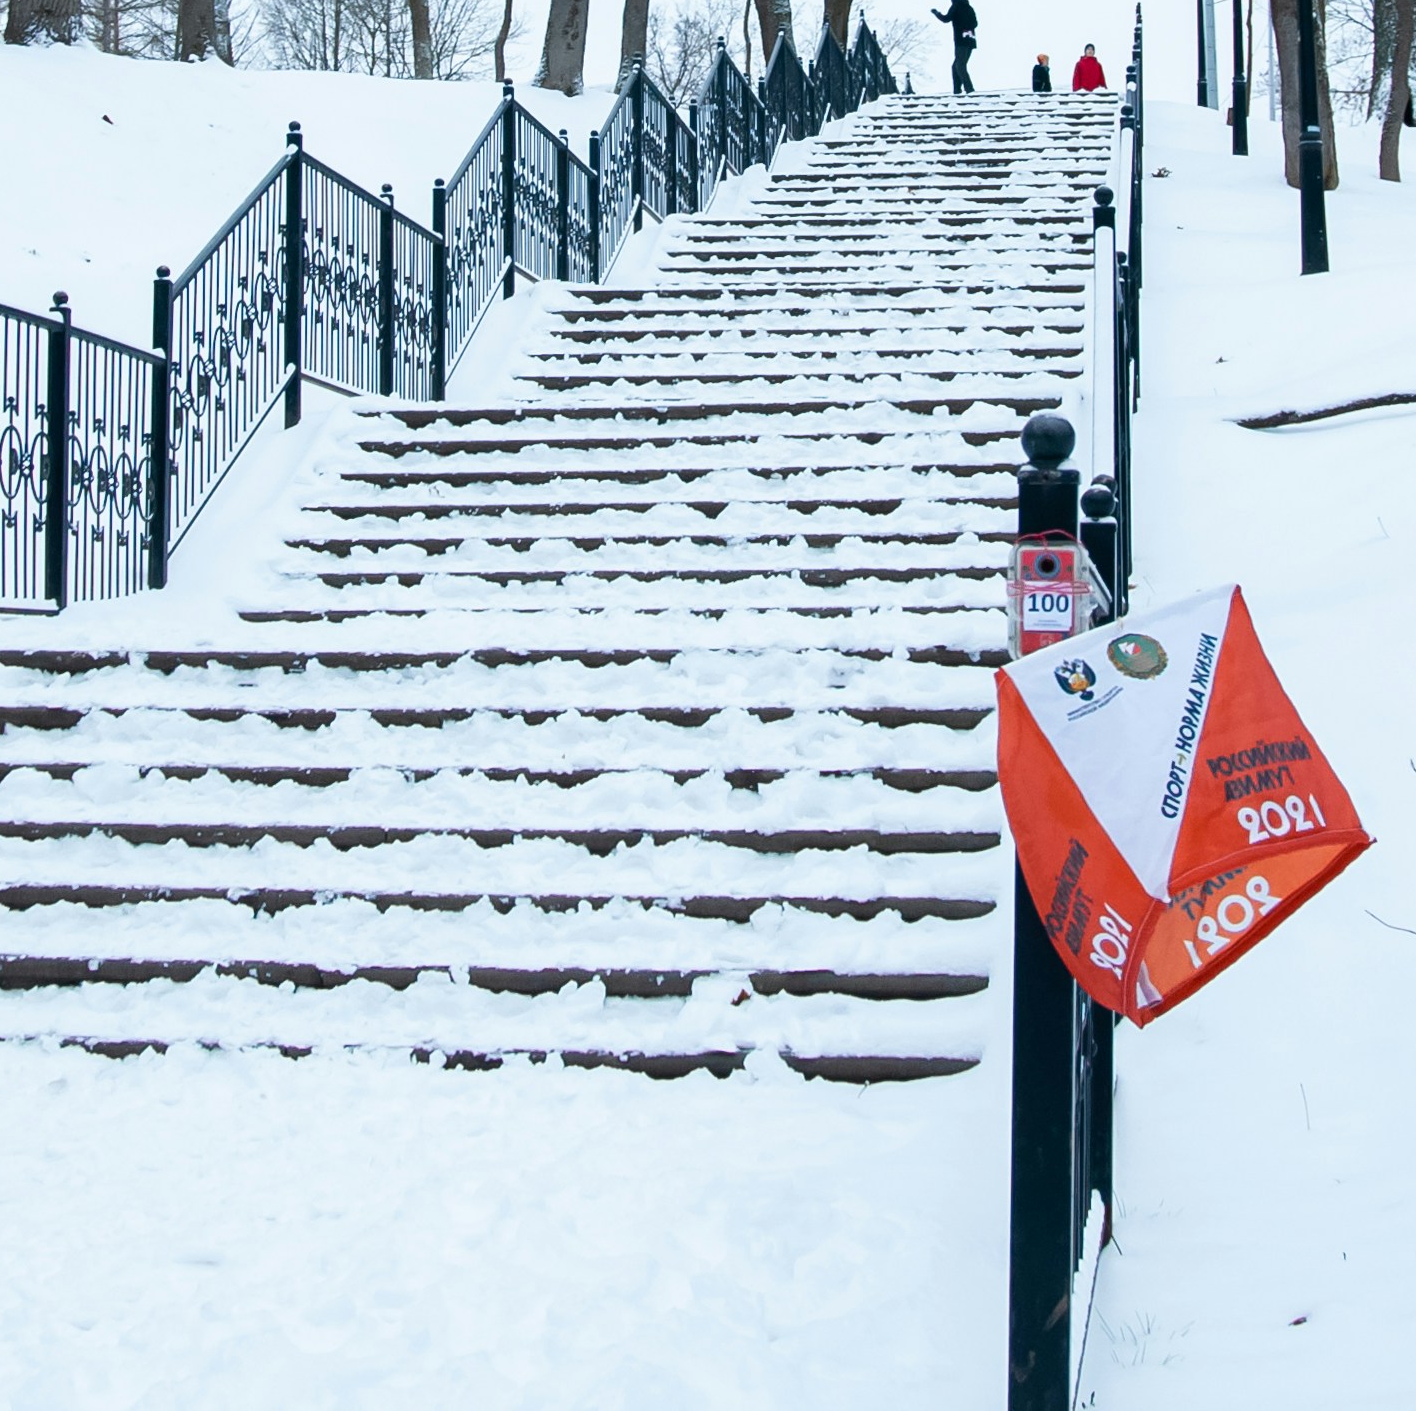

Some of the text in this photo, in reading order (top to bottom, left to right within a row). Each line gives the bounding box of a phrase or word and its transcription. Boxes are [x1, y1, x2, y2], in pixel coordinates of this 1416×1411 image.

[1028, 593, 1069, 613] 100
[1161, 632, 1218, 819] СПОРТ НОРМА ЖИЗНИ
[1237, 792, 1327, 845] 2021
[1089, 901, 1133, 981] 2021
